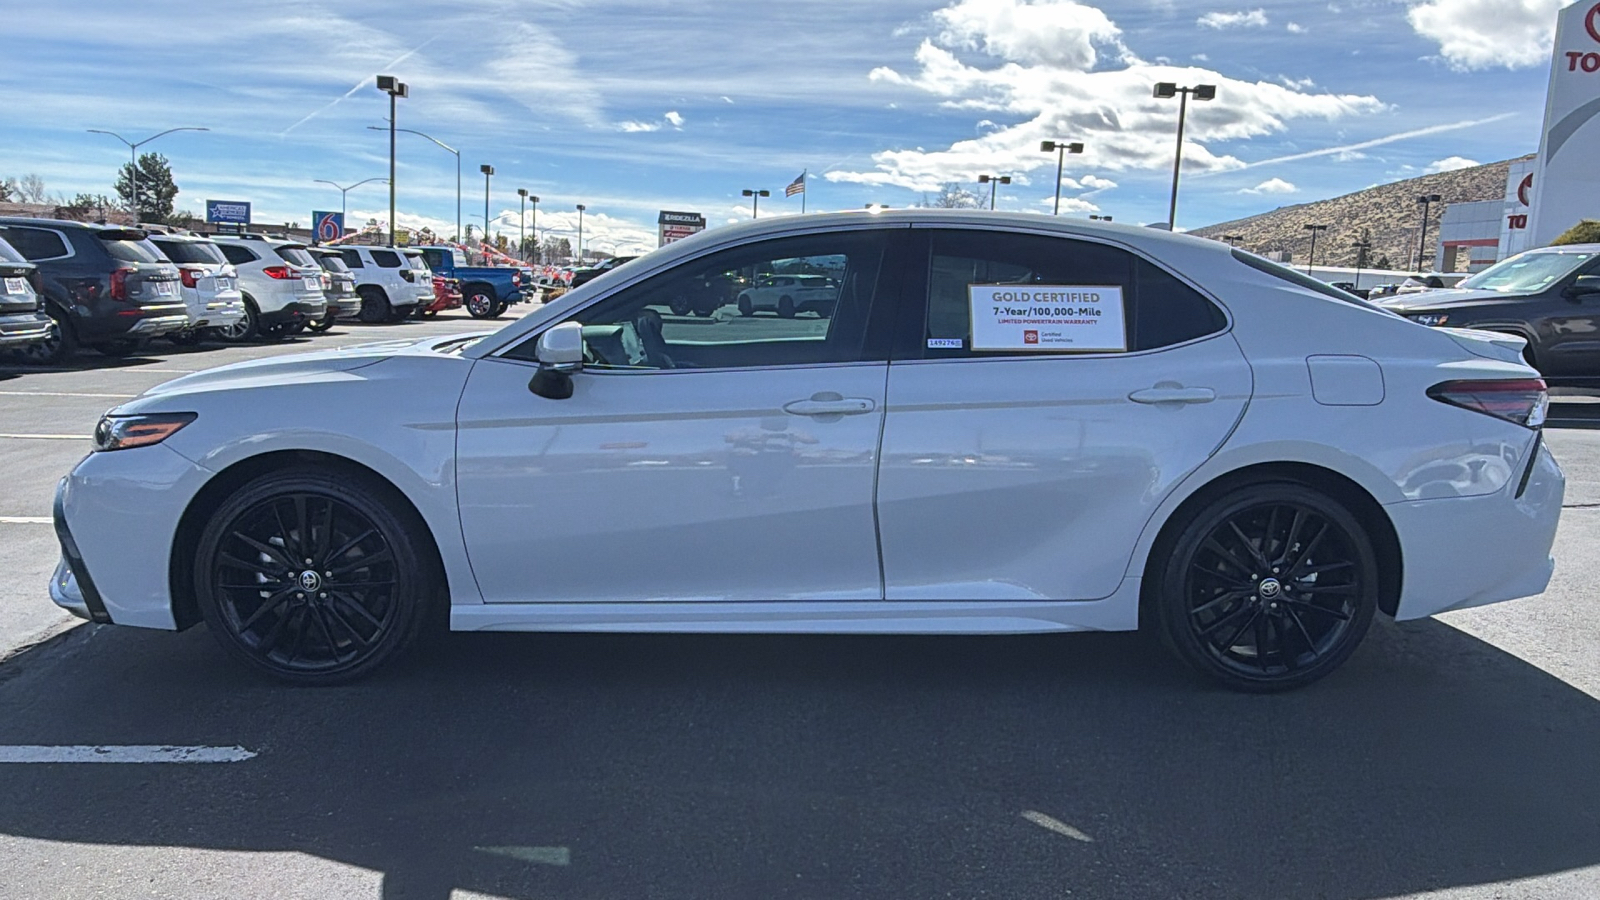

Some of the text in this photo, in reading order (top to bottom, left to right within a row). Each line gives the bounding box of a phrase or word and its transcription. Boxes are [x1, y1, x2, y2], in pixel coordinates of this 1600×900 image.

[1565, 51, 1600, 72] TO
[318, 213, 339, 241] 6
[992, 292, 1101, 303] GOLD CERTIFIED
[993, 307, 1102, 317] 7-Year/100,000-Mile
